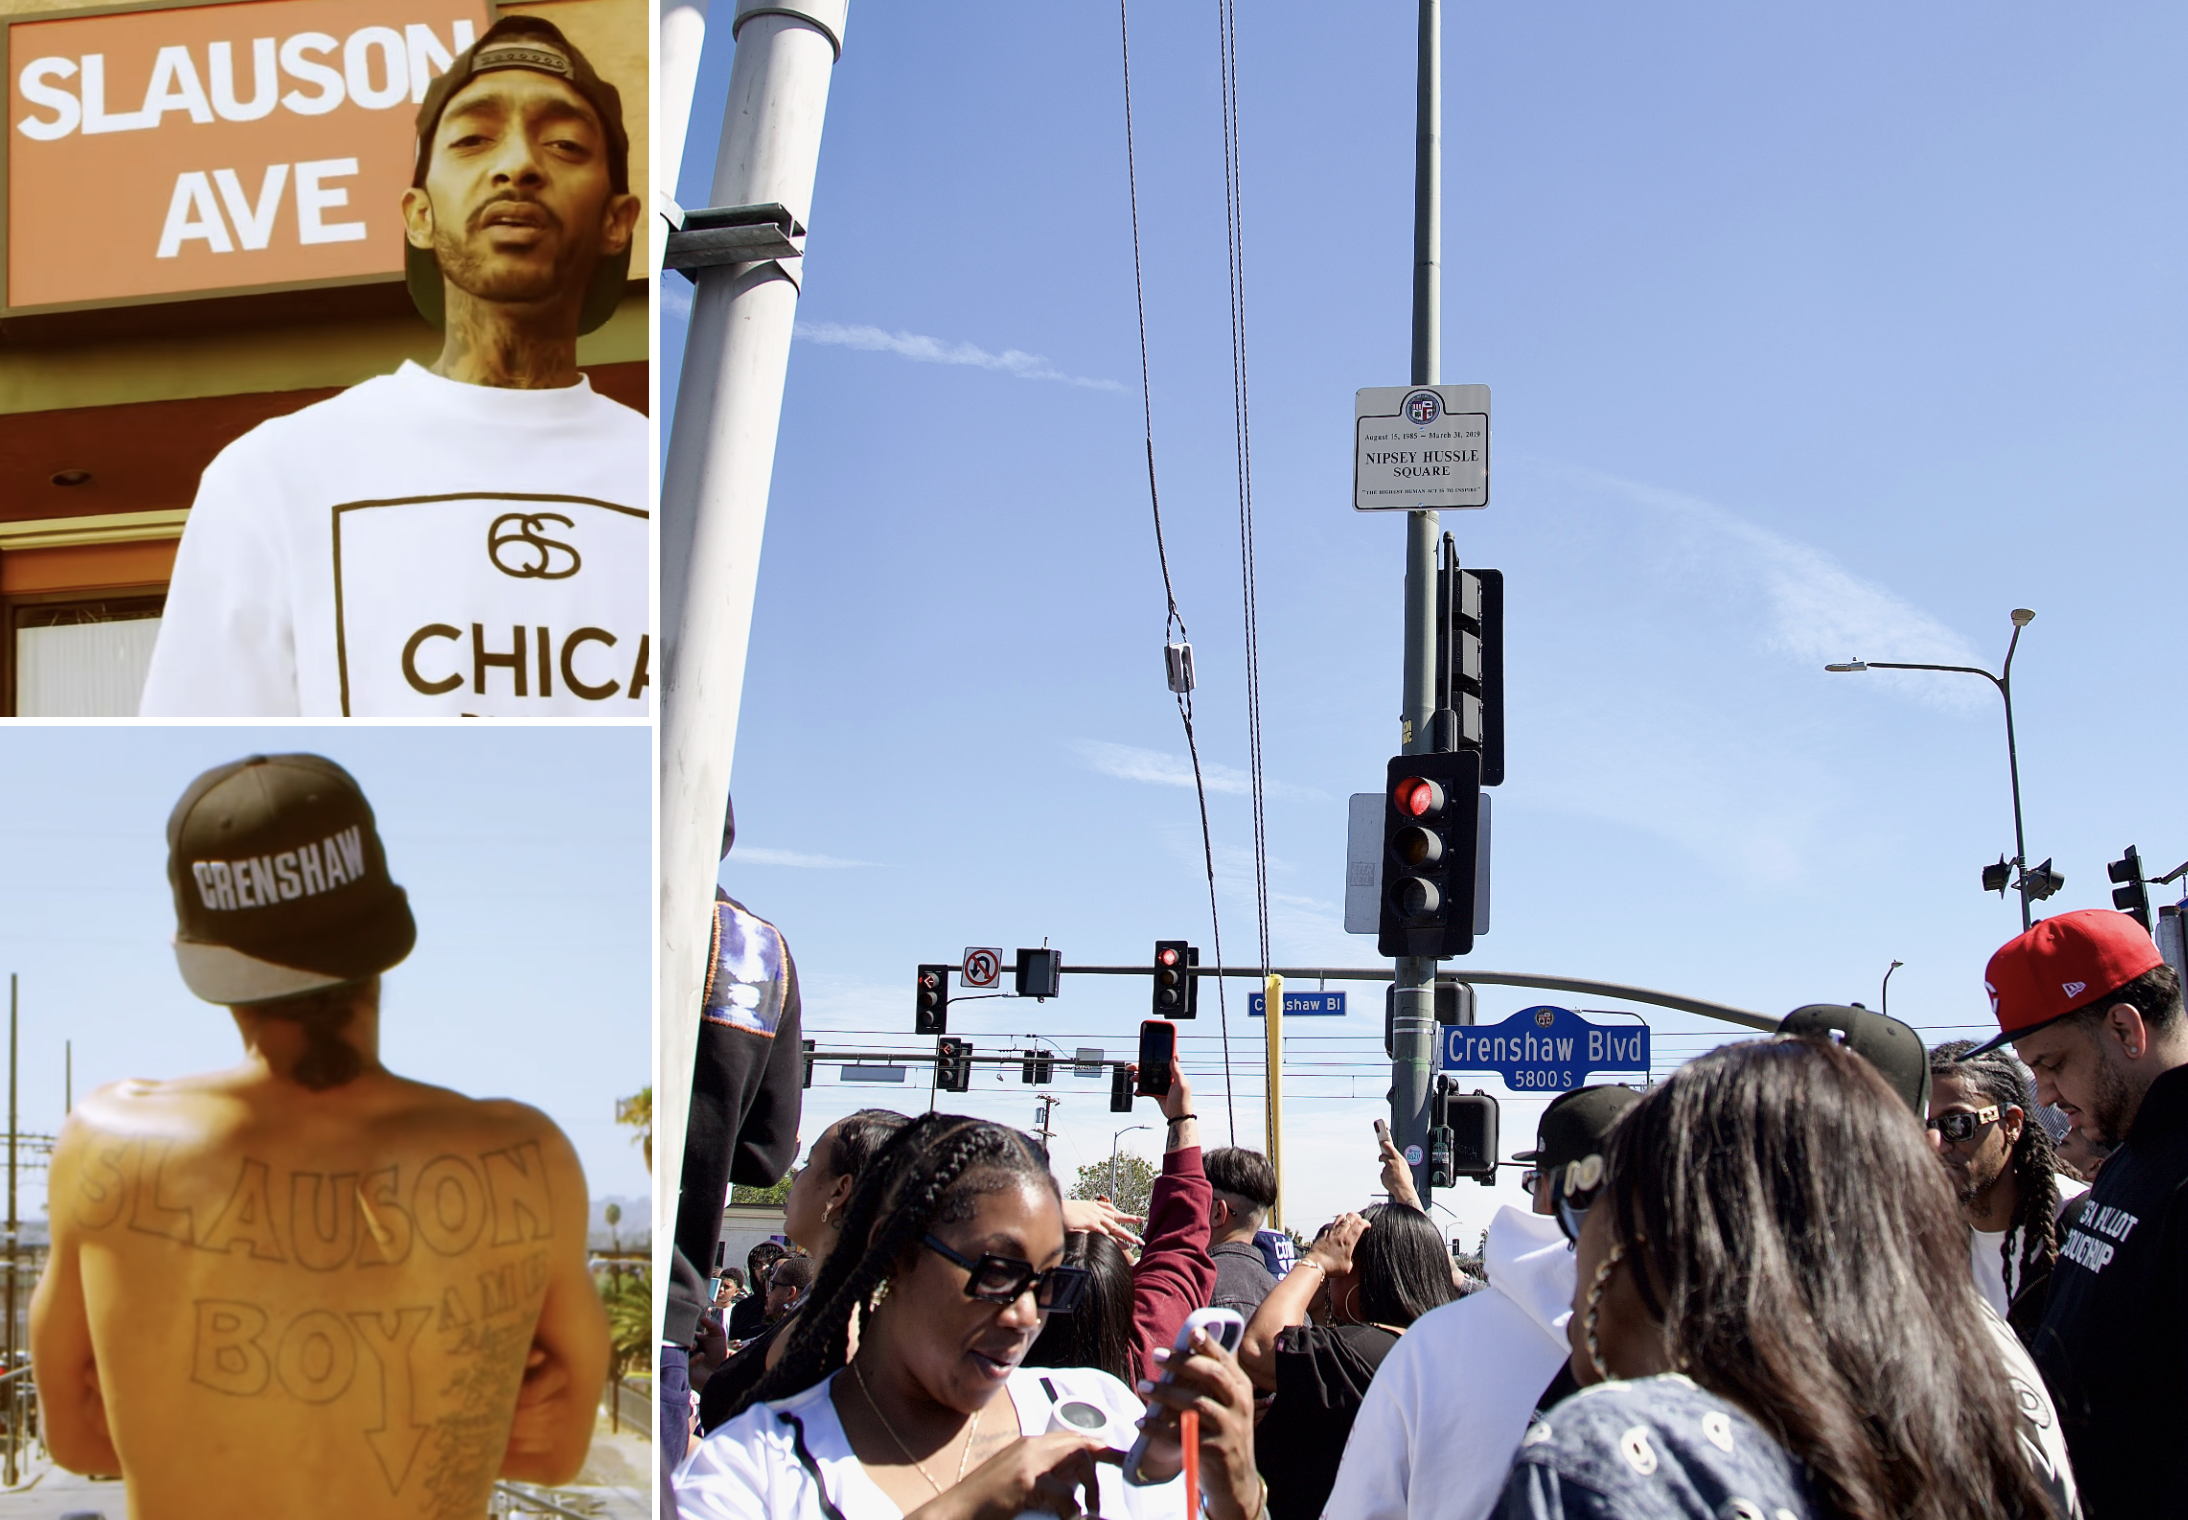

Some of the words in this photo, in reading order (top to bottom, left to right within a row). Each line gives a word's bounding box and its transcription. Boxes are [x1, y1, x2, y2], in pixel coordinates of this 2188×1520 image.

[17, 19, 474, 141] SLAUSON
[156, 158, 367, 259] AVE
[1365, 451, 1417, 465] NIPSEY
[1423, 449, 1479, 463] HUSSLE
[1393, 466, 1451, 479] SQUARE
[192, 825, 365, 911] CRENSHAW
[1254, 998, 1320, 1011] Cshaw
[1327, 997, 1340, 1011] Bl
[1449, 1030, 1574, 1062] Crenshaw
[1588, 1030, 1641, 1062] Blvd
[1515, 1070, 1558, 1088] 5800
[1563, 1070, 1572, 1088] S
[75, 1134, 554, 1274] SLAUSON
[188, 1297, 434, 1432] BOY
